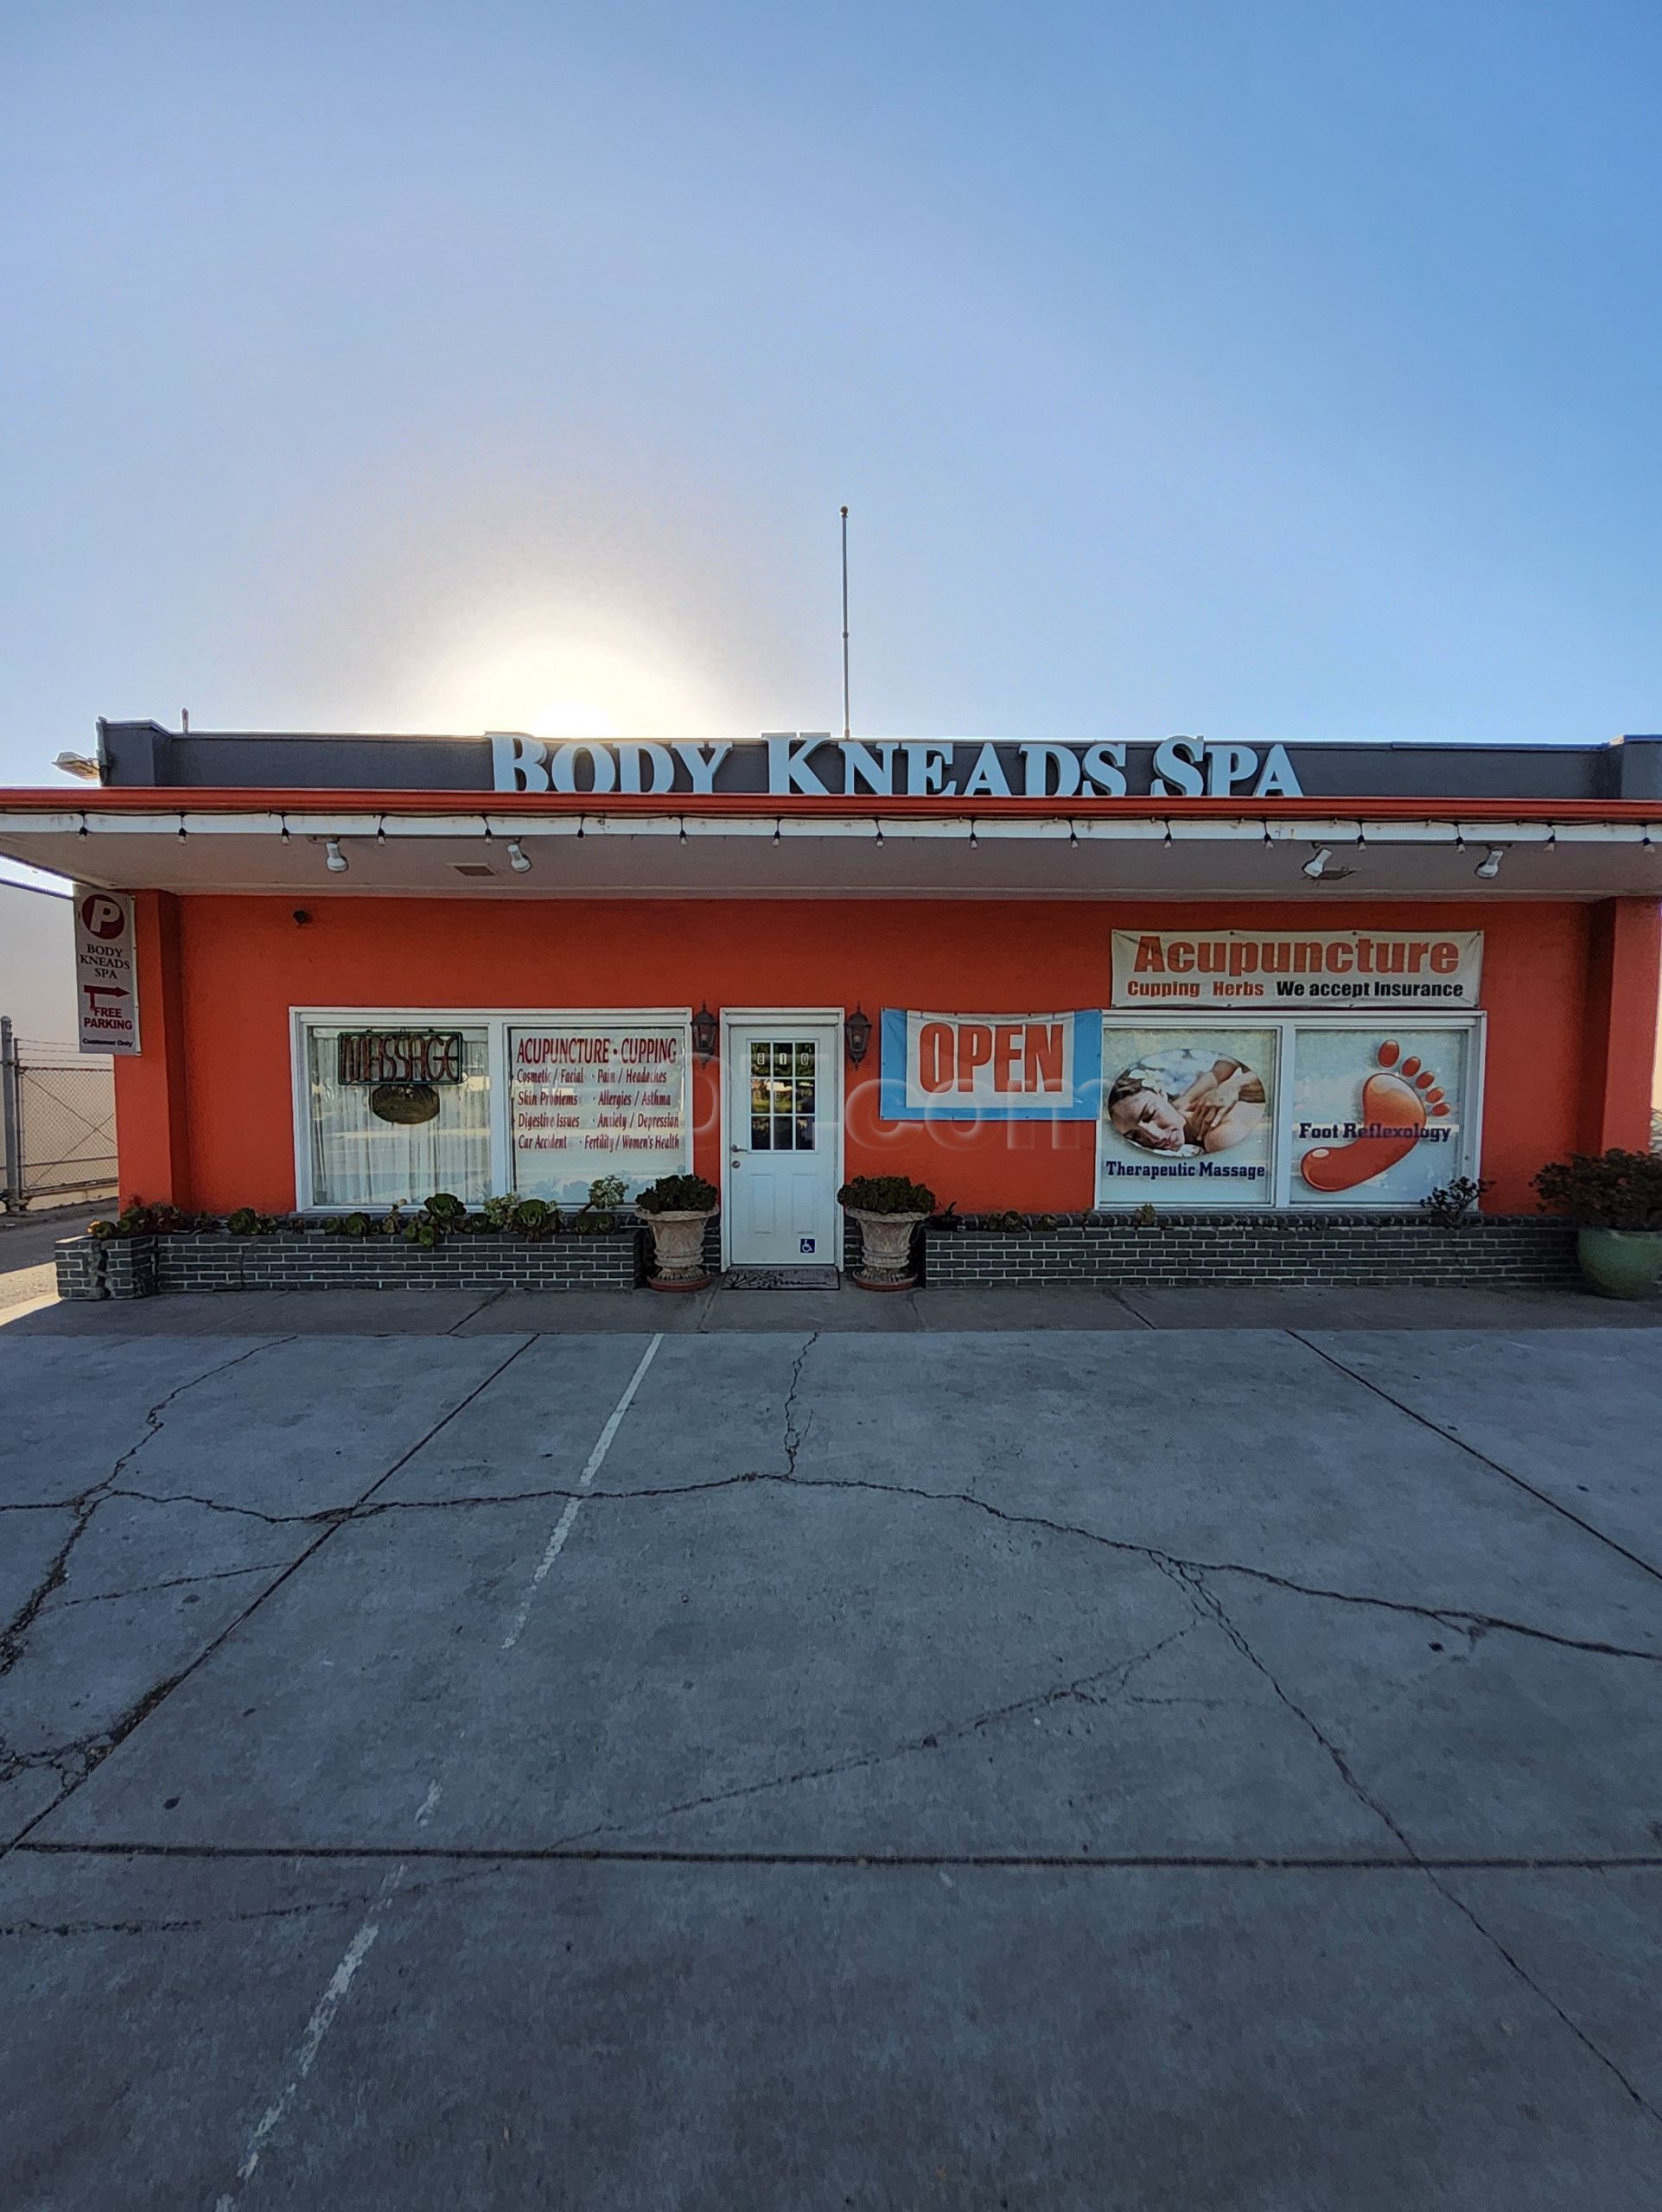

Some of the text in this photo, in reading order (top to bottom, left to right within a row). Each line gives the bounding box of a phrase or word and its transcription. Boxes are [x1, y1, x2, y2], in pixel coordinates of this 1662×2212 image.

[487, 733, 1304, 797] BODY KNEADS SPA
[90, 899, 120, 933] P
[87, 944, 123, 957] BODY
[1133, 935, 1460, 977] Acupuncture
[80, 954, 130, 969] KNEADS
[95, 968, 118, 980] SPA
[1127, 981, 1464, 998] Cupping Herbs We accept Insurance
[94, 1007, 122, 1019] FREE
[84, 1017, 133, 1030] PARKING
[82, 1038, 133, 1048] Customer Only
[516, 1038, 677, 1064] ACUPUNCTURE CUPPING
[340, 1034, 460, 1082] MASSAGE
[919, 1021, 1064, 1094] OPEN
[517, 1068, 551, 1083] Cosmetic
[561, 1068, 584, 1083] Facial
[597, 1069, 615, 1083] Pain
[626, 1068, 667, 1083] Headaches
[519, 1091, 538, 1106] Skin
[540, 1090, 578, 1106] Problems
[598, 1090, 632, 1109] Allergies
[641, 1090, 671, 1106] Asthma
[519, 1113, 555, 1131] Digestive
[557, 1113, 580, 1128] Issues
[597, 1113, 627, 1131] Anxiety
[638, 1112, 679, 1131] Depression
[1298, 1122, 1452, 1142] Foot Reflexology
[519, 1135, 533, 1149] Car
[534, 1135, 567, 1149] Accident
[584, 1135, 614, 1153] Fertility
[622, 1135, 653, 1149] Women's
[654, 1134, 679, 1149] Health
[1105, 1161, 1265, 1179] Therapeutic Massage
